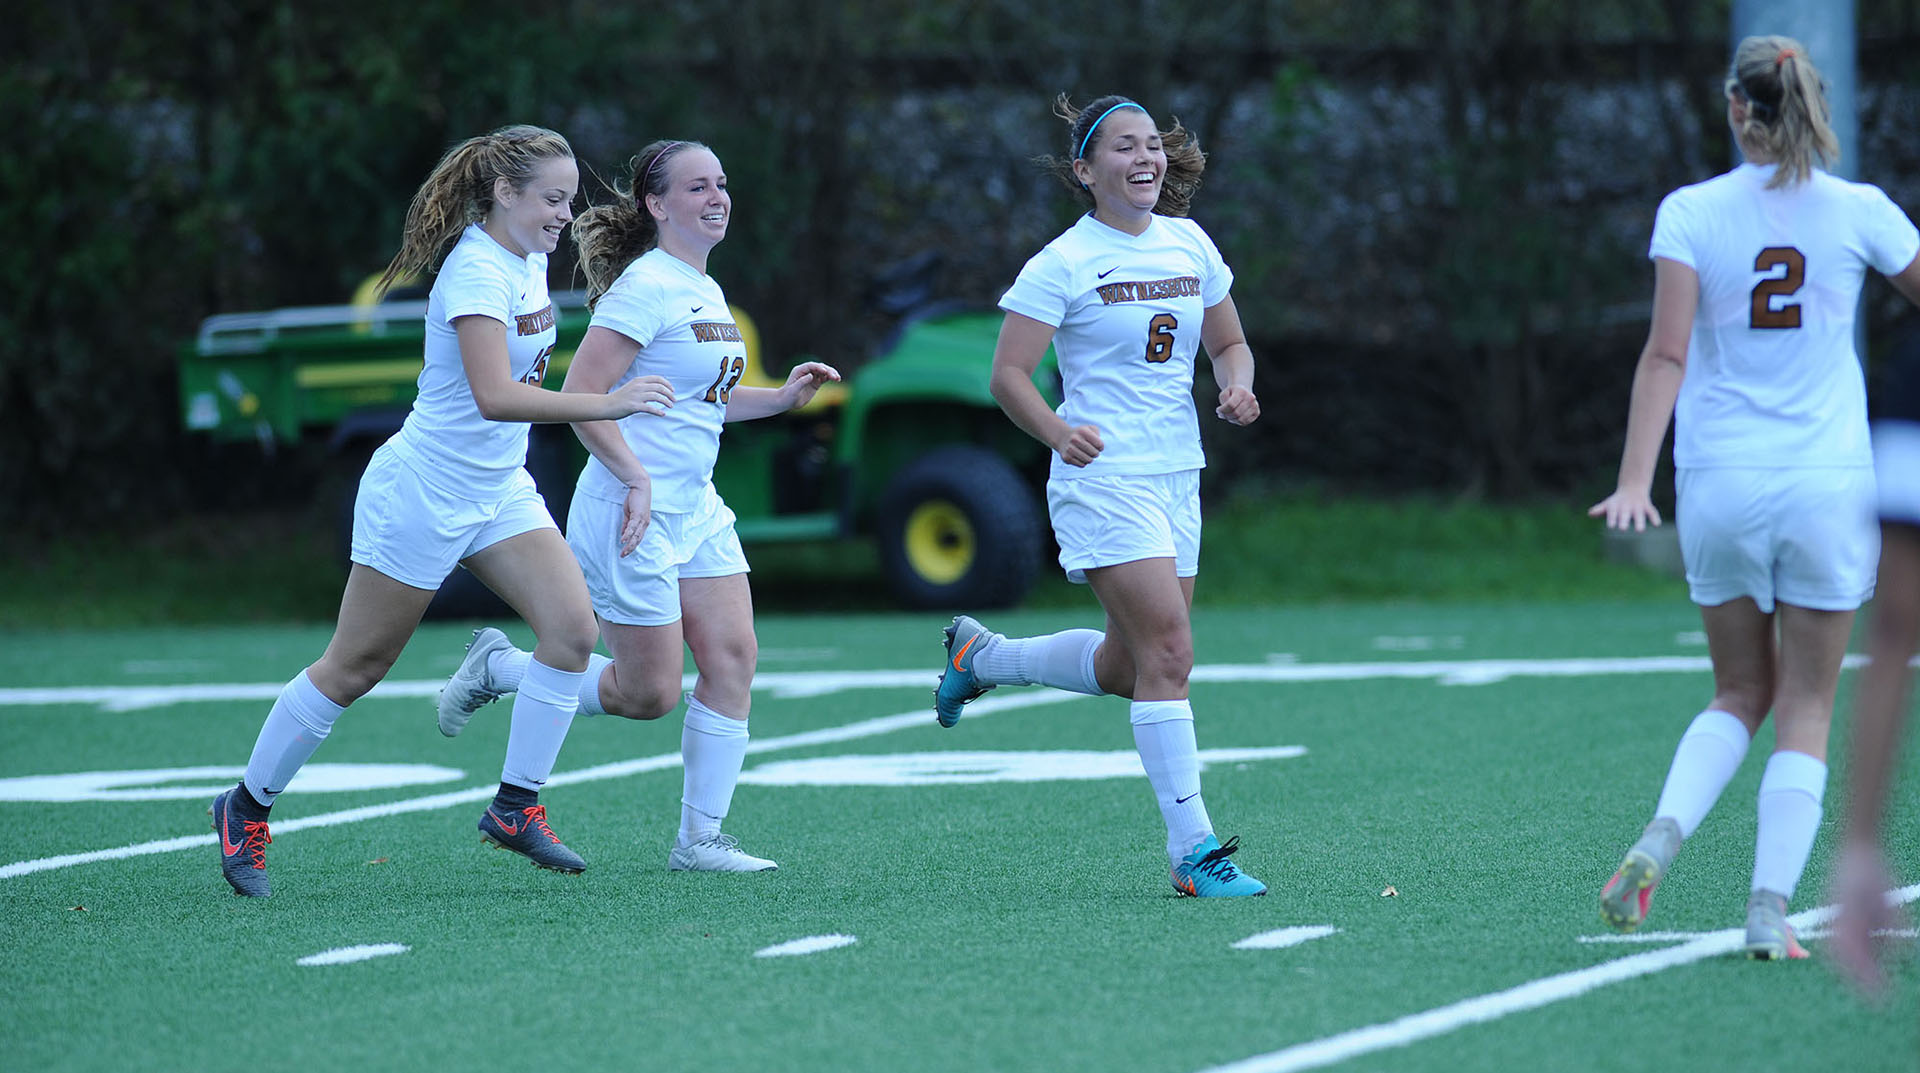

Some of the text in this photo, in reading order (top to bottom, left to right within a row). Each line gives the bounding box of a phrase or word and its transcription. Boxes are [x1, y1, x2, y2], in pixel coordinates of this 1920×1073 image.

[1750, 247, 1806, 329] 2
[1145, 312, 1178, 363] 6
[703, 355, 745, 405] 13
